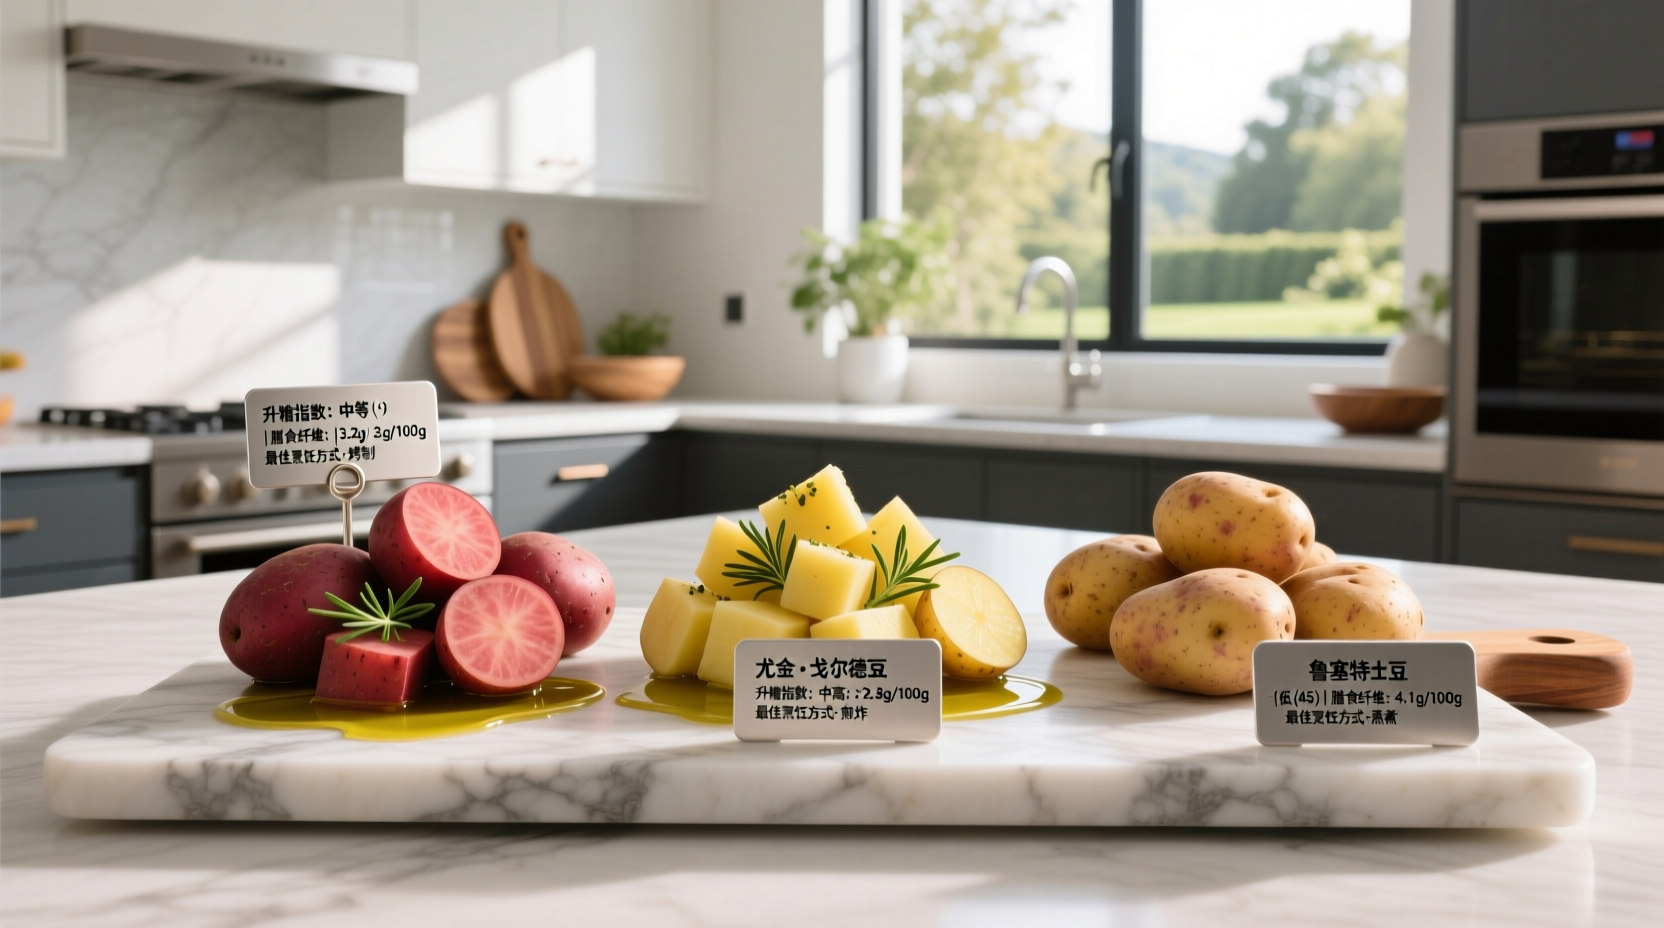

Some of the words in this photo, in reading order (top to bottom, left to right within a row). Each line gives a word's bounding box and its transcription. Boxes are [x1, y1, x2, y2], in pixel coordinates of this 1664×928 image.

[1309, 658, 1409, 682] 鲁塞特土豆
